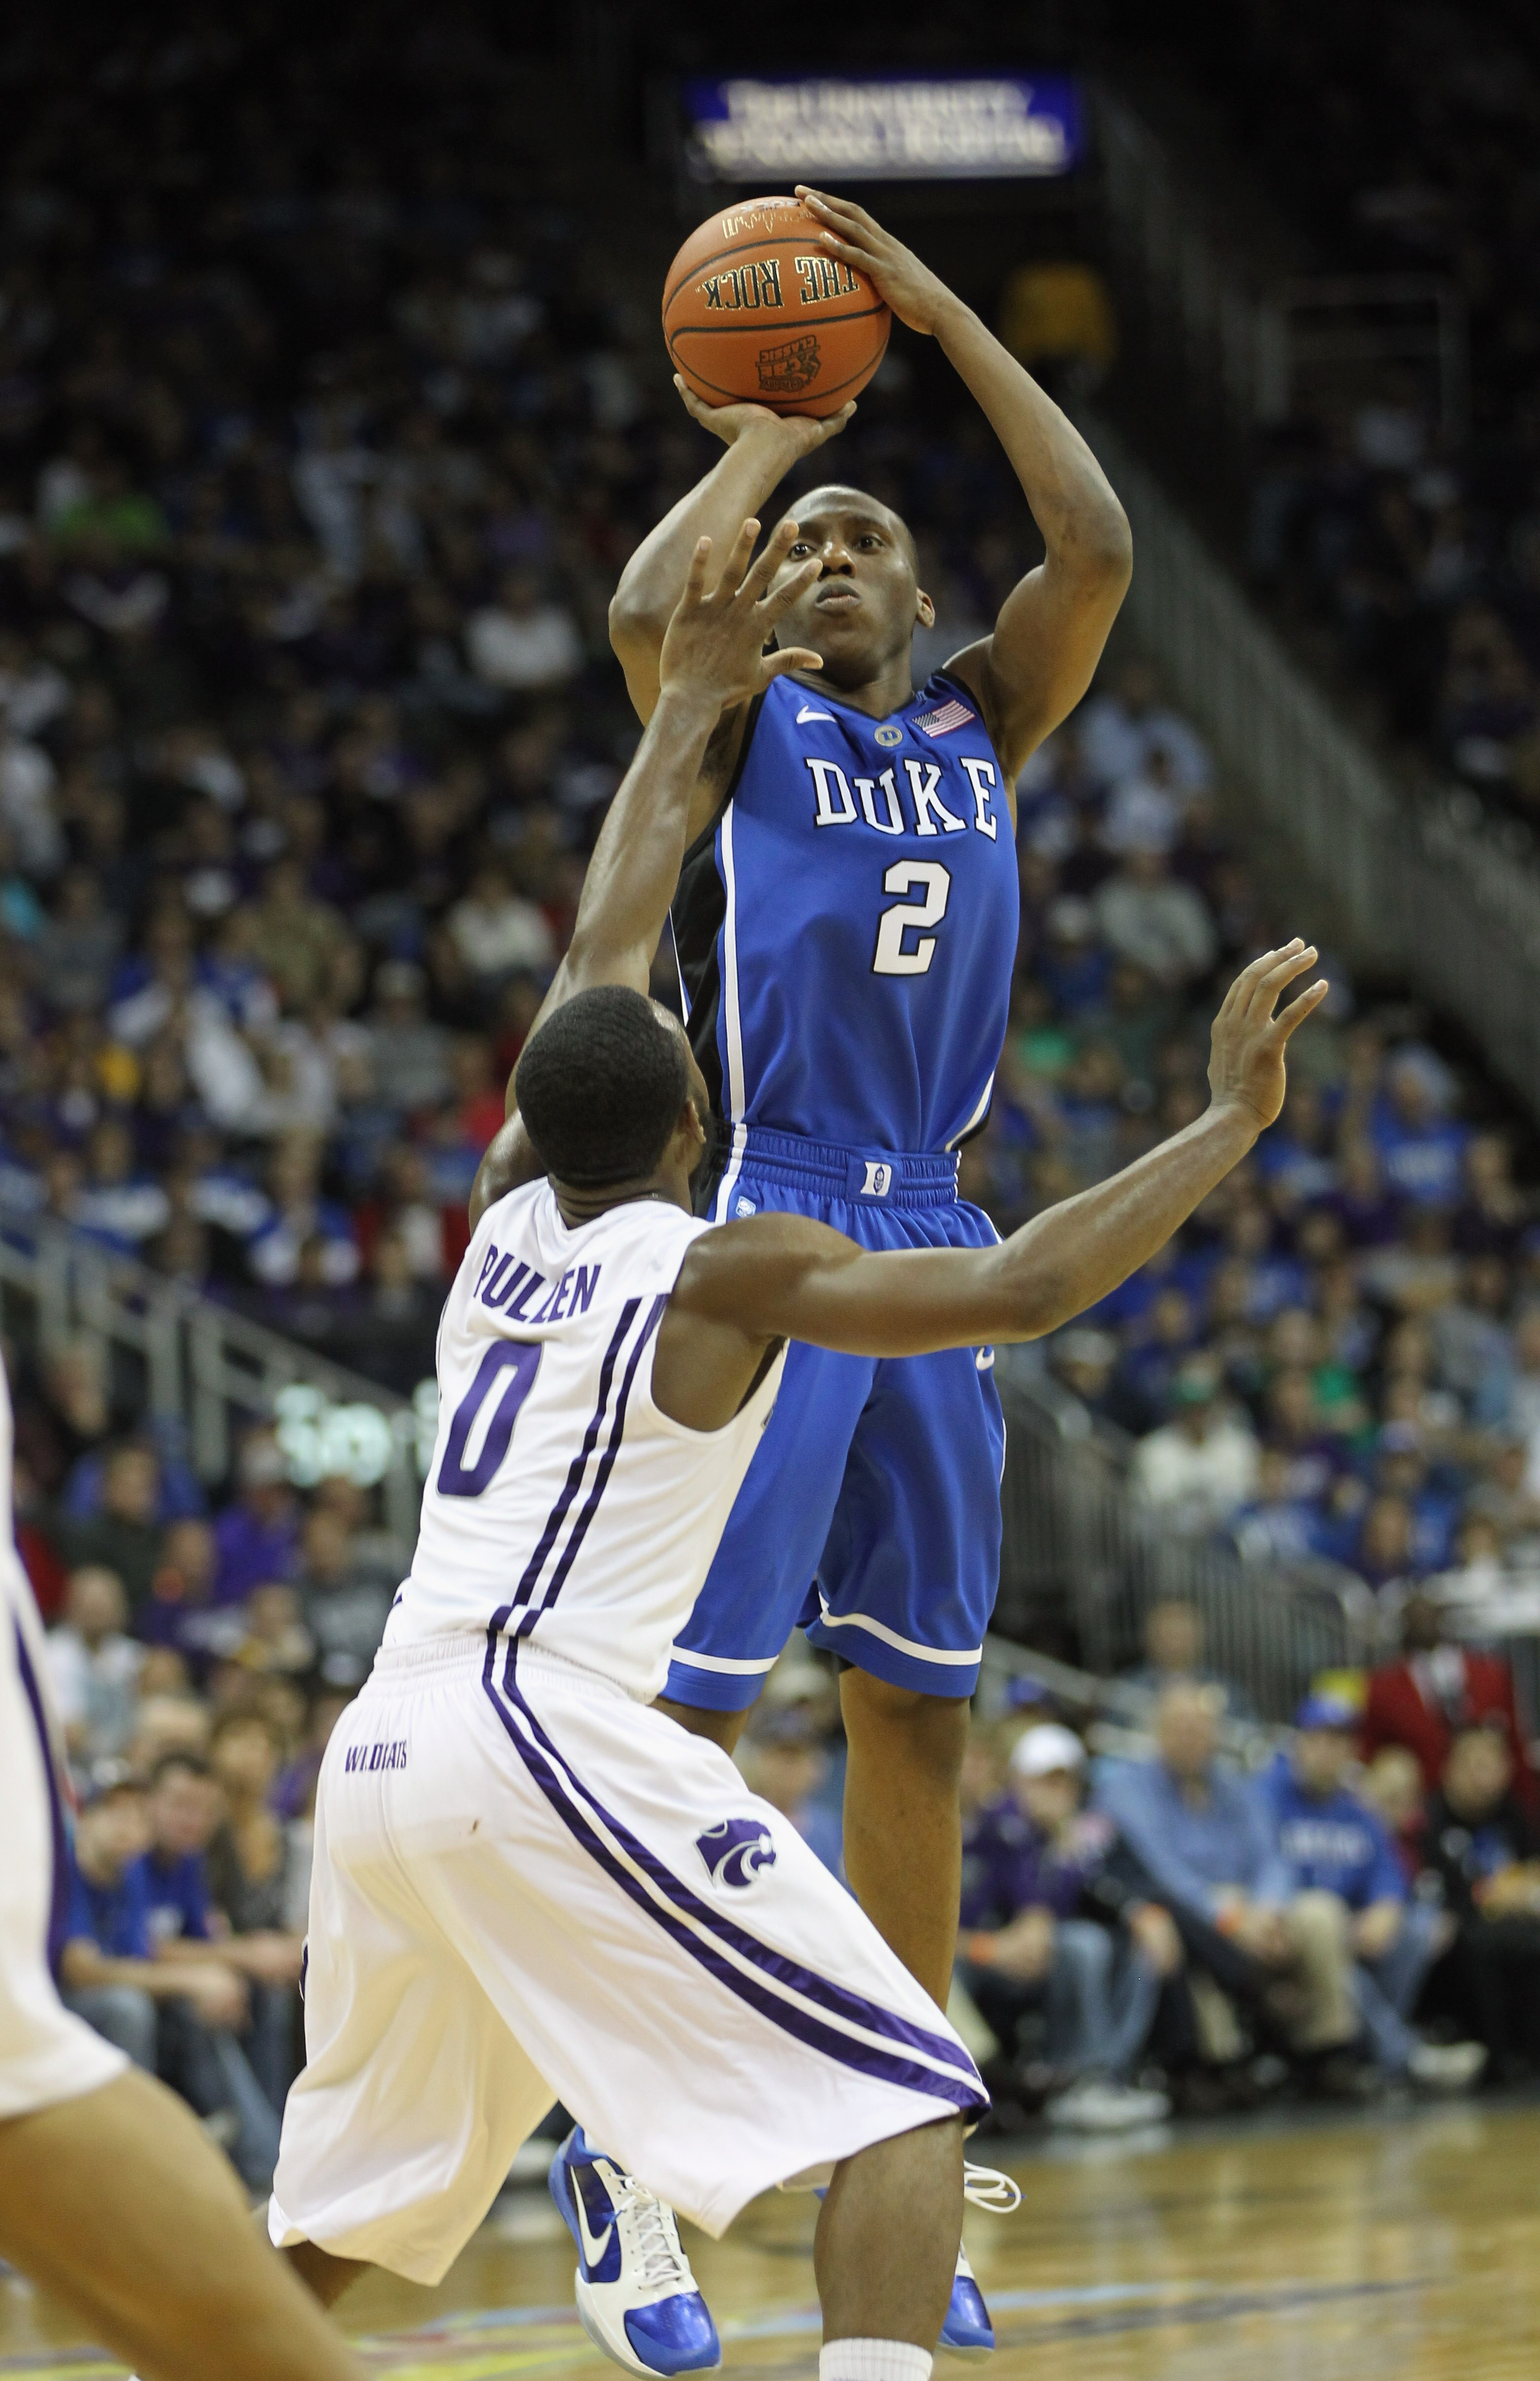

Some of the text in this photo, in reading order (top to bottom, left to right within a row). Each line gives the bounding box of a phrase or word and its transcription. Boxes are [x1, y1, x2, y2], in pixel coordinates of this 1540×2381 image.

[701, 256, 860, 311] THE ROCK
[806, 758, 997, 842] DUKE
[872, 859, 952, 975] 2
[437, 1339, 543, 1497] 0
[345, 1740, 407, 1772] WIDATS
